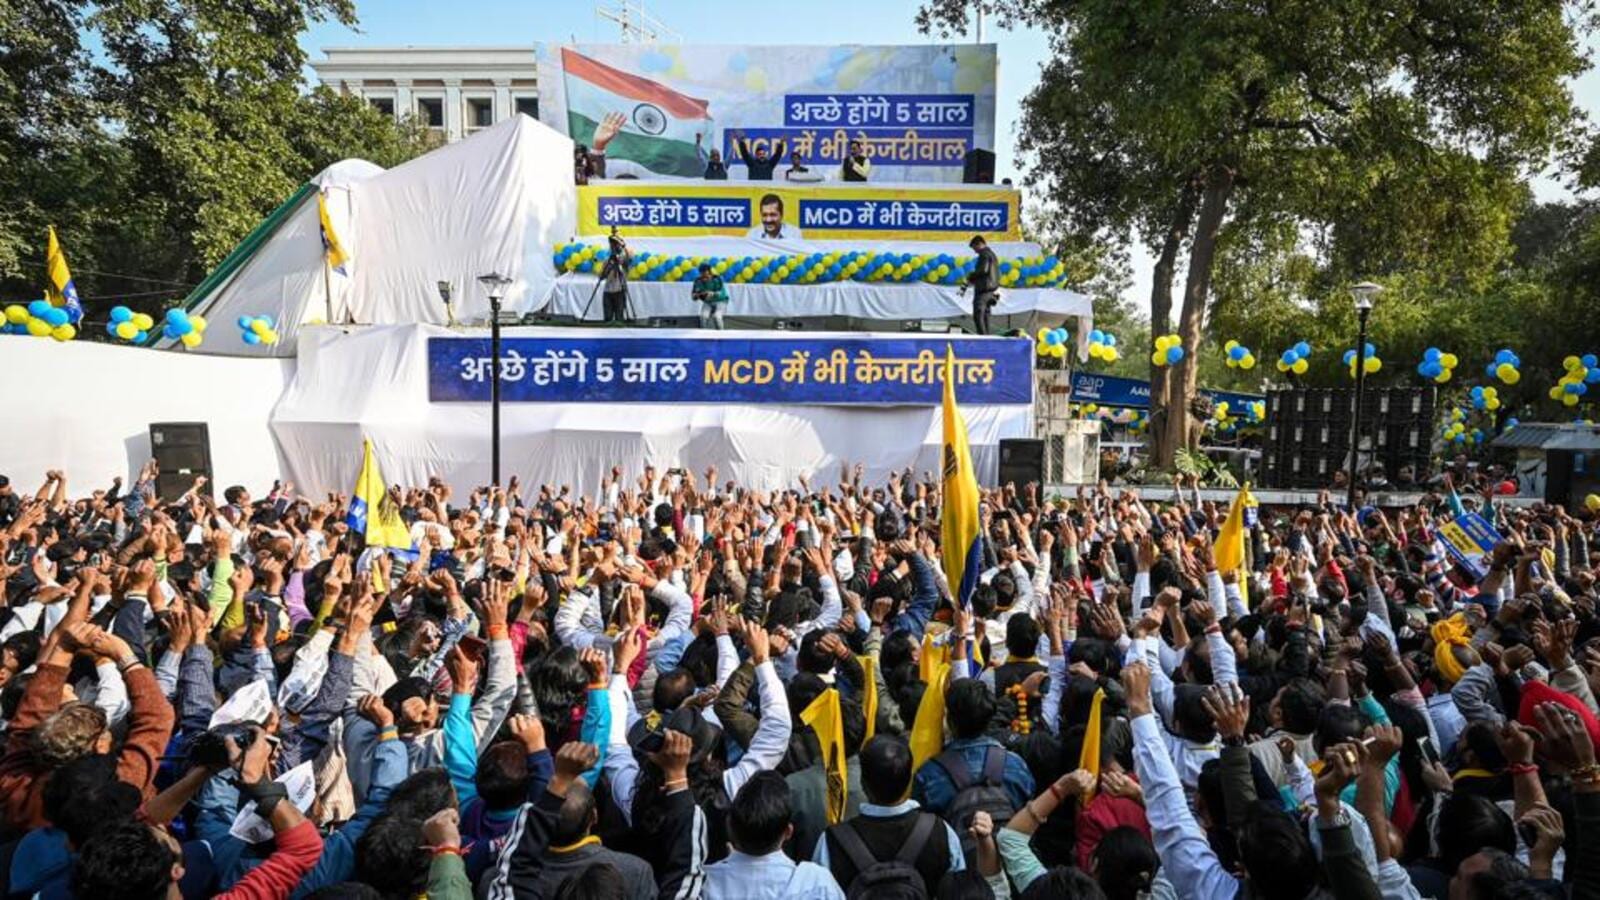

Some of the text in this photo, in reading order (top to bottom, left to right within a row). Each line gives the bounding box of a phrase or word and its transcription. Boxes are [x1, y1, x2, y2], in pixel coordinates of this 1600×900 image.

[791, 96, 969, 125] अच्छे होंगे 5 साल
[792, 129, 817, 160] में
[820, 129, 849, 160] भी
[603, 199, 746, 224] अच्छे होंगे 5 साल
[805, 202, 1003, 228] MCD में भी केजरीवाल
[531, 350, 588, 385] होंगे
[596, 359, 614, 382] 5
[621, 358, 690, 383] साल
[704, 359, 774, 384] MCD
[780, 350, 810, 384] में
[813, 350, 849, 384] भी
